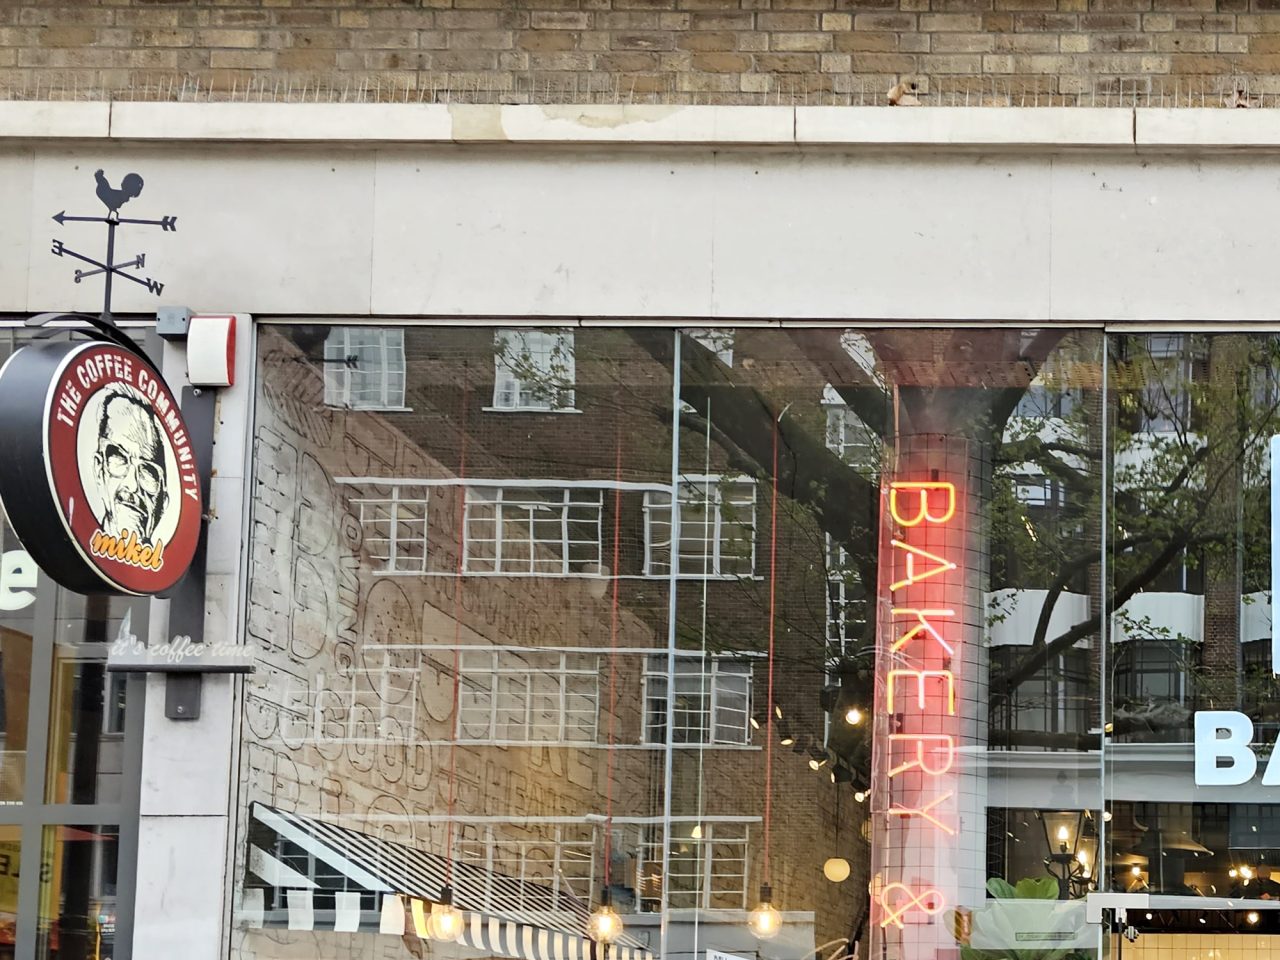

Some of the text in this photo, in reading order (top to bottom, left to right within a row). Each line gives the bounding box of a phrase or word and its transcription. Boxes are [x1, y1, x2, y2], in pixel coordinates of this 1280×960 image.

[56, 354, 199, 501] THE COFFEE COMMUNITY
[91, 528, 164, 572] mikel
[149, 635, 204, 663] coffee
[211, 641, 253, 657] time
[887, 481, 958, 836] BAKERY
[880, 882, 946, 930] &
